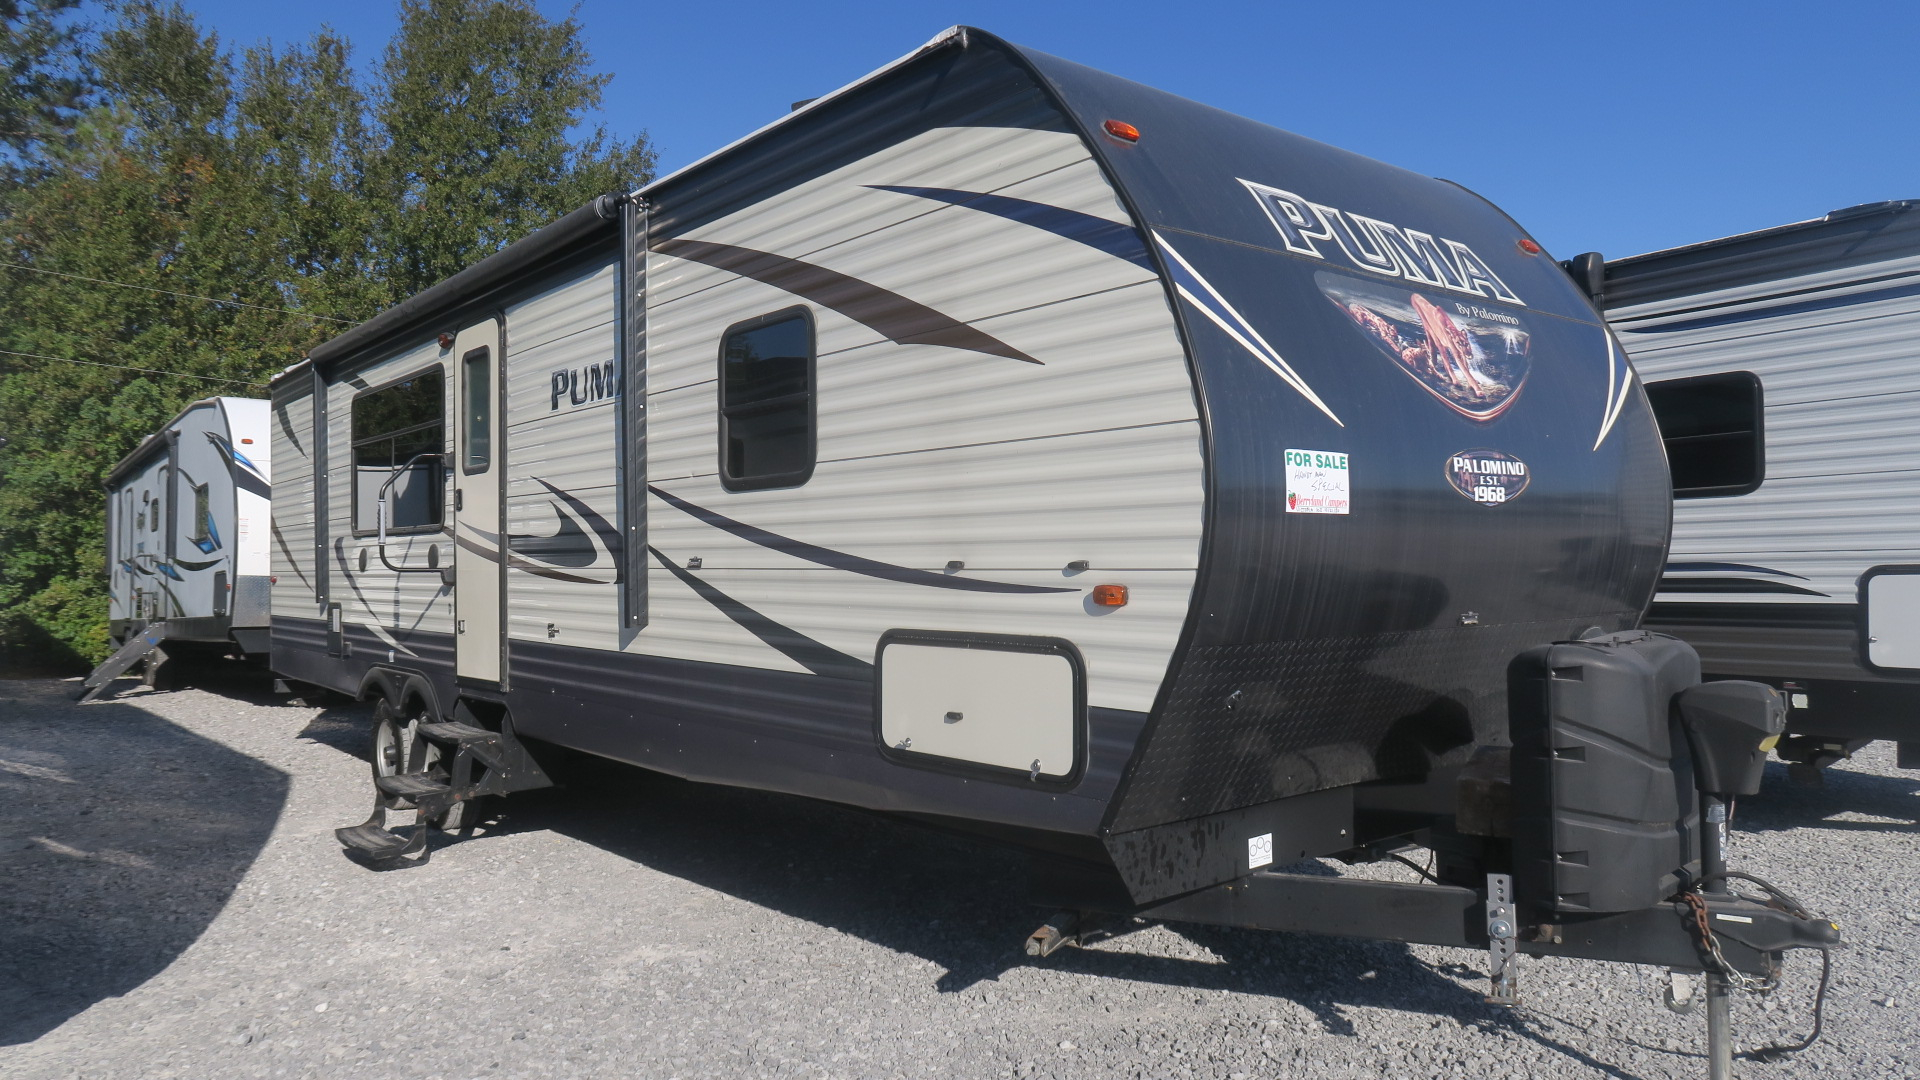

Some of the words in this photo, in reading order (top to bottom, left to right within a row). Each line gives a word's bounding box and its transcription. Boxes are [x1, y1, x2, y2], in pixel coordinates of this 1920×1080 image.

[1234, 176, 1527, 306] PUMA
[1455, 303, 1470, 317] By
[1471, 306, 1519, 325] Palomino
[1286, 452, 1312, 467] FOR
[1315, 453, 1347, 470] SALE
[1453, 457, 1525, 476] PALOMINO
[1480, 475, 1500, 486] EST.
[1473, 486, 1506, 502] 1968
